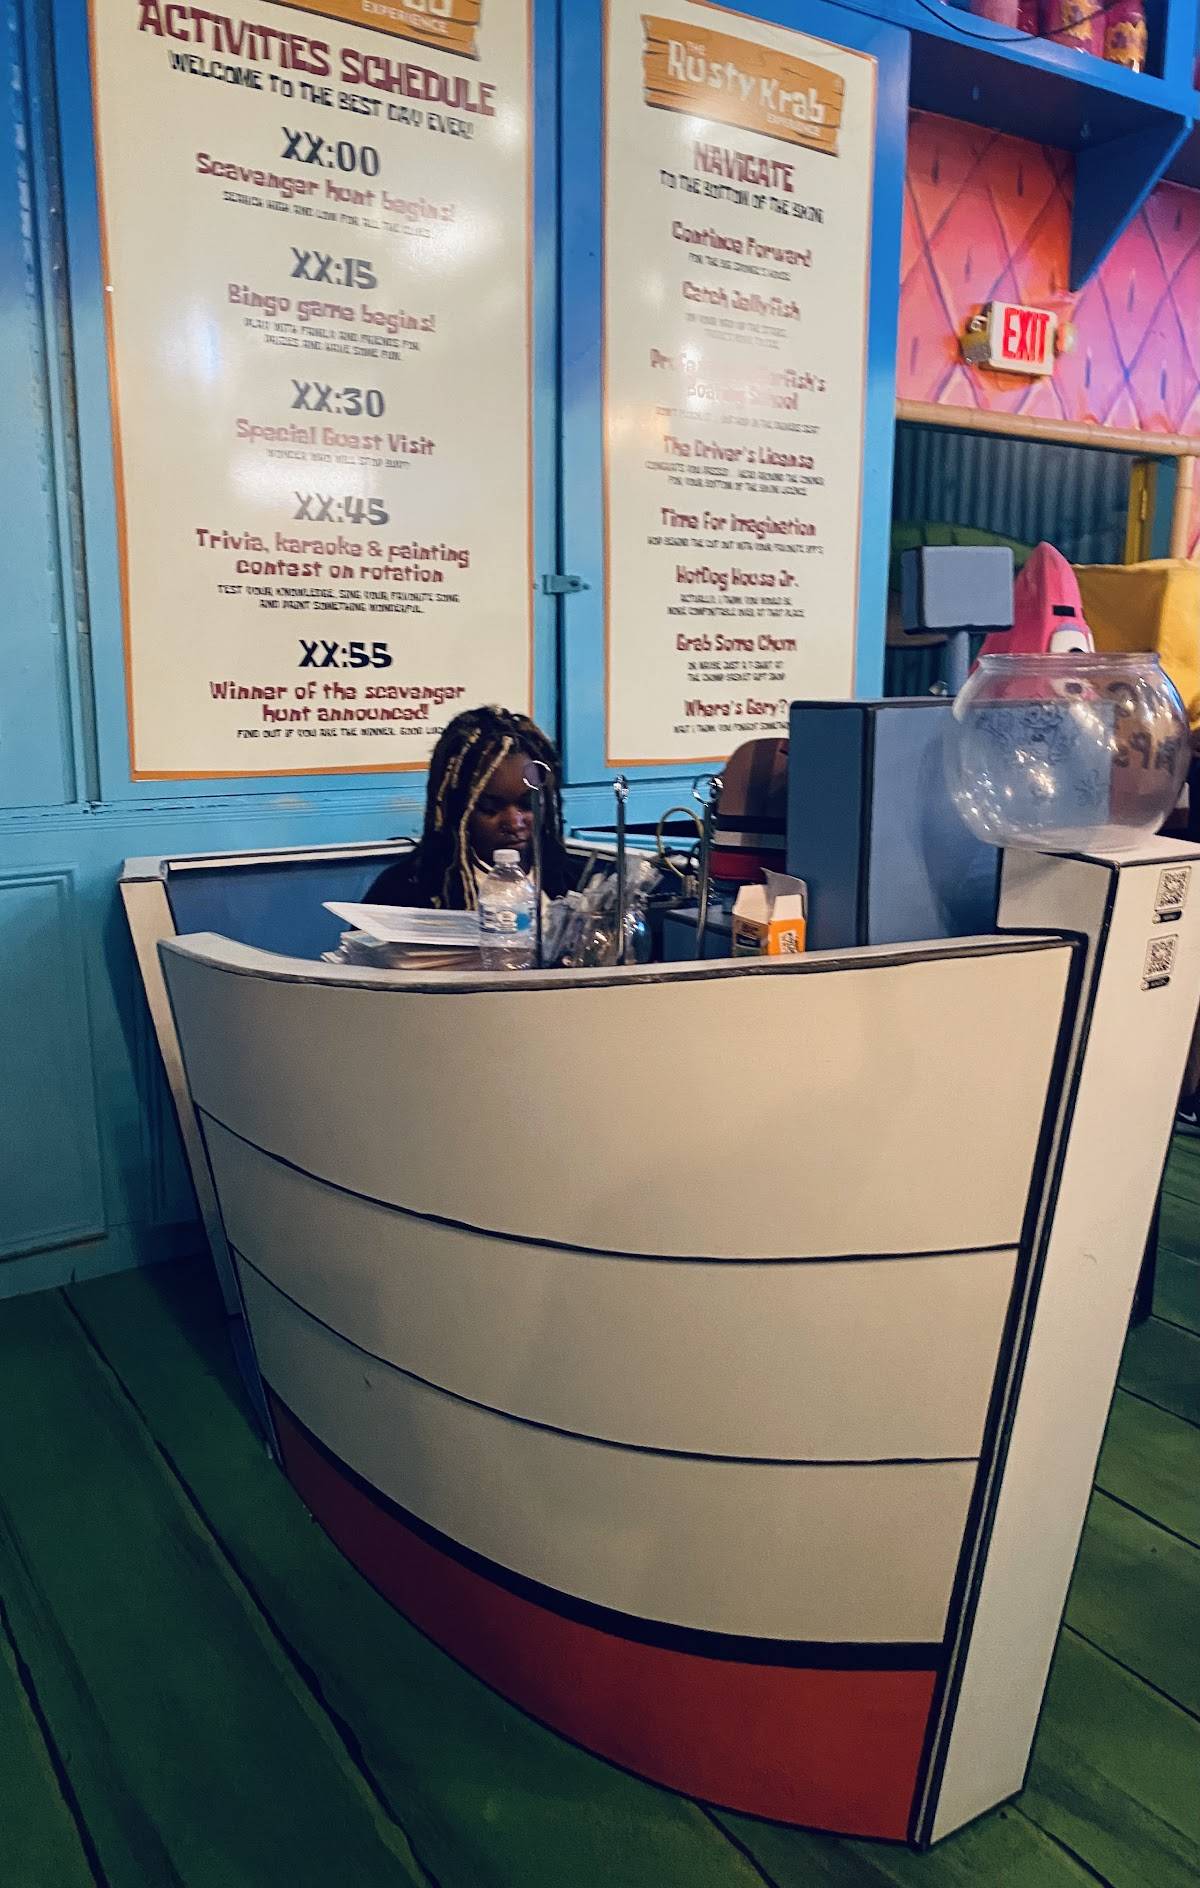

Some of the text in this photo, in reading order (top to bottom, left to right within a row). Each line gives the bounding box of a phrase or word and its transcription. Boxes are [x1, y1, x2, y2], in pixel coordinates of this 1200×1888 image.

[361, 1, 449, 36] EXPERIENCE
[138, 0, 497, 117] ACTIVITIES SCHEDULE
[167, 49, 263, 90] WELCOME
[267, 73, 294, 98] TO
[299, 81, 334, 107] THE
[337, 91, 382, 117] BEST
[387, 102, 423, 128] DAY
[758, 77, 826, 124] Krab
[281, 126, 380, 176] XX:00
[694, 141, 796, 193] NAVIGATE
[195, 152, 320, 199] Scavenger
[325, 179, 376, 207] hunt
[679, 174, 701, 194] THE
[290, 247, 379, 290] XX:15
[745, 236, 813, 268] Forward
[228, 283, 291, 317] Bingo
[297, 300, 355, 321] game
[1003, 307, 1050, 363] EXIT
[291, 379, 386, 418] XX:30
[236, 418, 437, 457] Special Guest Visit
[293, 490, 390, 526] XX:45
[662, 507, 699, 530] Time
[195, 528, 470, 568] Trivia, karaoke & painting
[328, 565, 354, 579] on
[359, 563, 444, 582] rotation
[731, 567, 775, 587] House
[298, 640, 393, 668] XX:55
[676, 633, 797, 652] Grab Some Chum
[209, 680, 465, 705] Winner of the scavenger
[683, 698, 788, 717] Where's Gary?
[262, 703, 429, 723] hunt announced!
